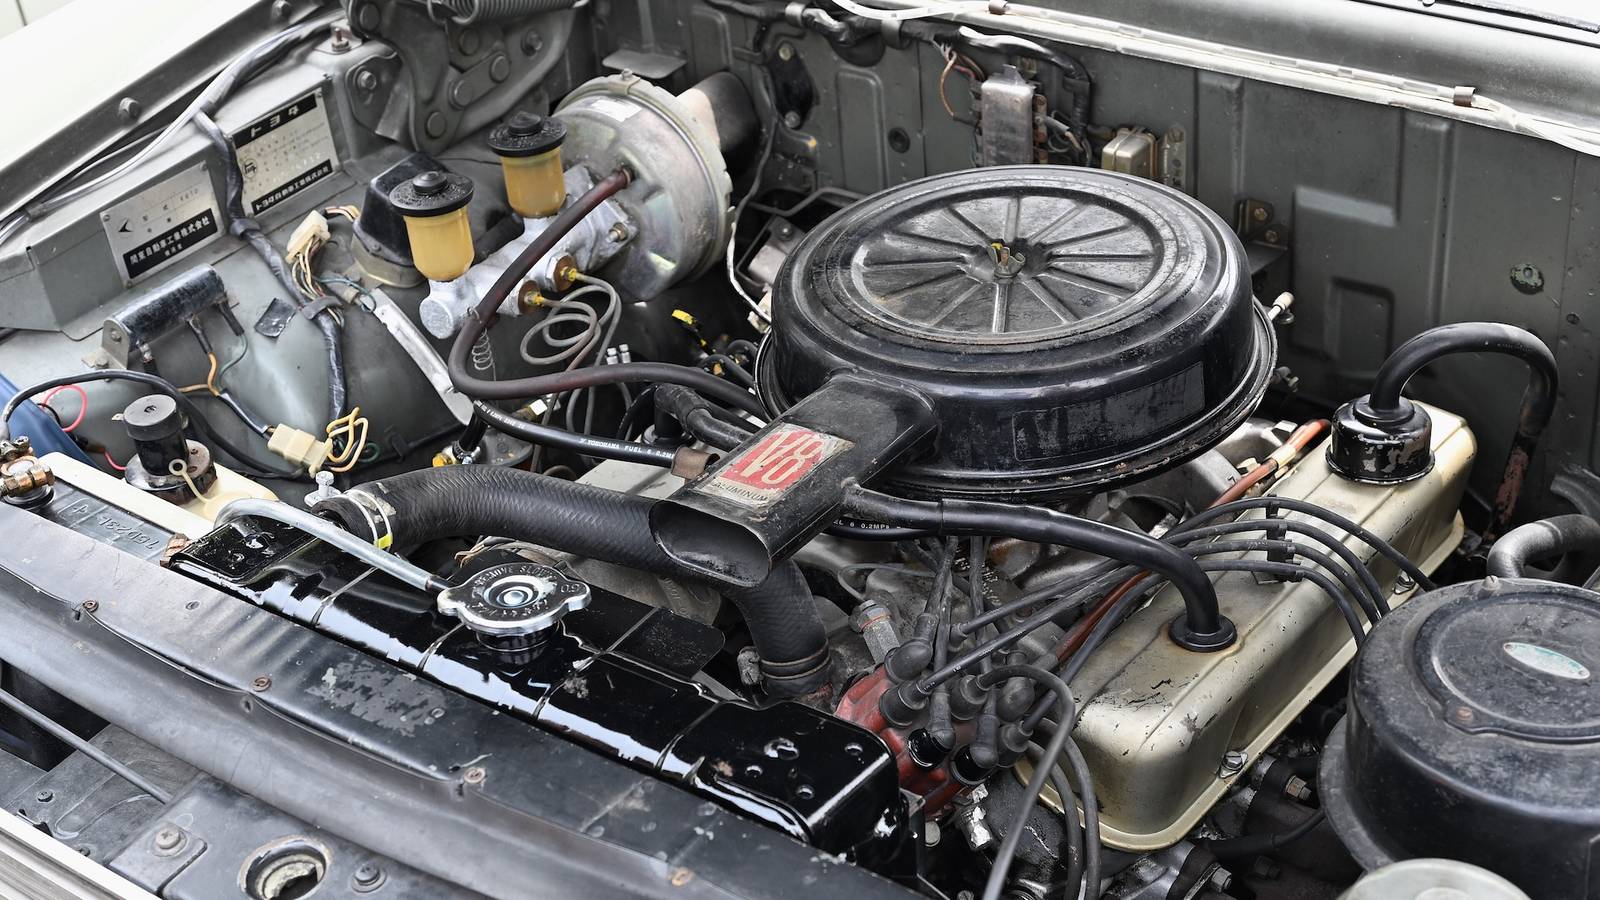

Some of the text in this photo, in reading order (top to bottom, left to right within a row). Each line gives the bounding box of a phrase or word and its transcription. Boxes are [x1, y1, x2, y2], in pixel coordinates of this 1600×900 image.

[250, 105, 301, 138] トヨタ
[624, 444, 643, 454] FUEL
[740, 429, 827, 486] V8
[712, 481, 770, 503] ALUMINUM
[560, 583, 581, 594] 0.9
